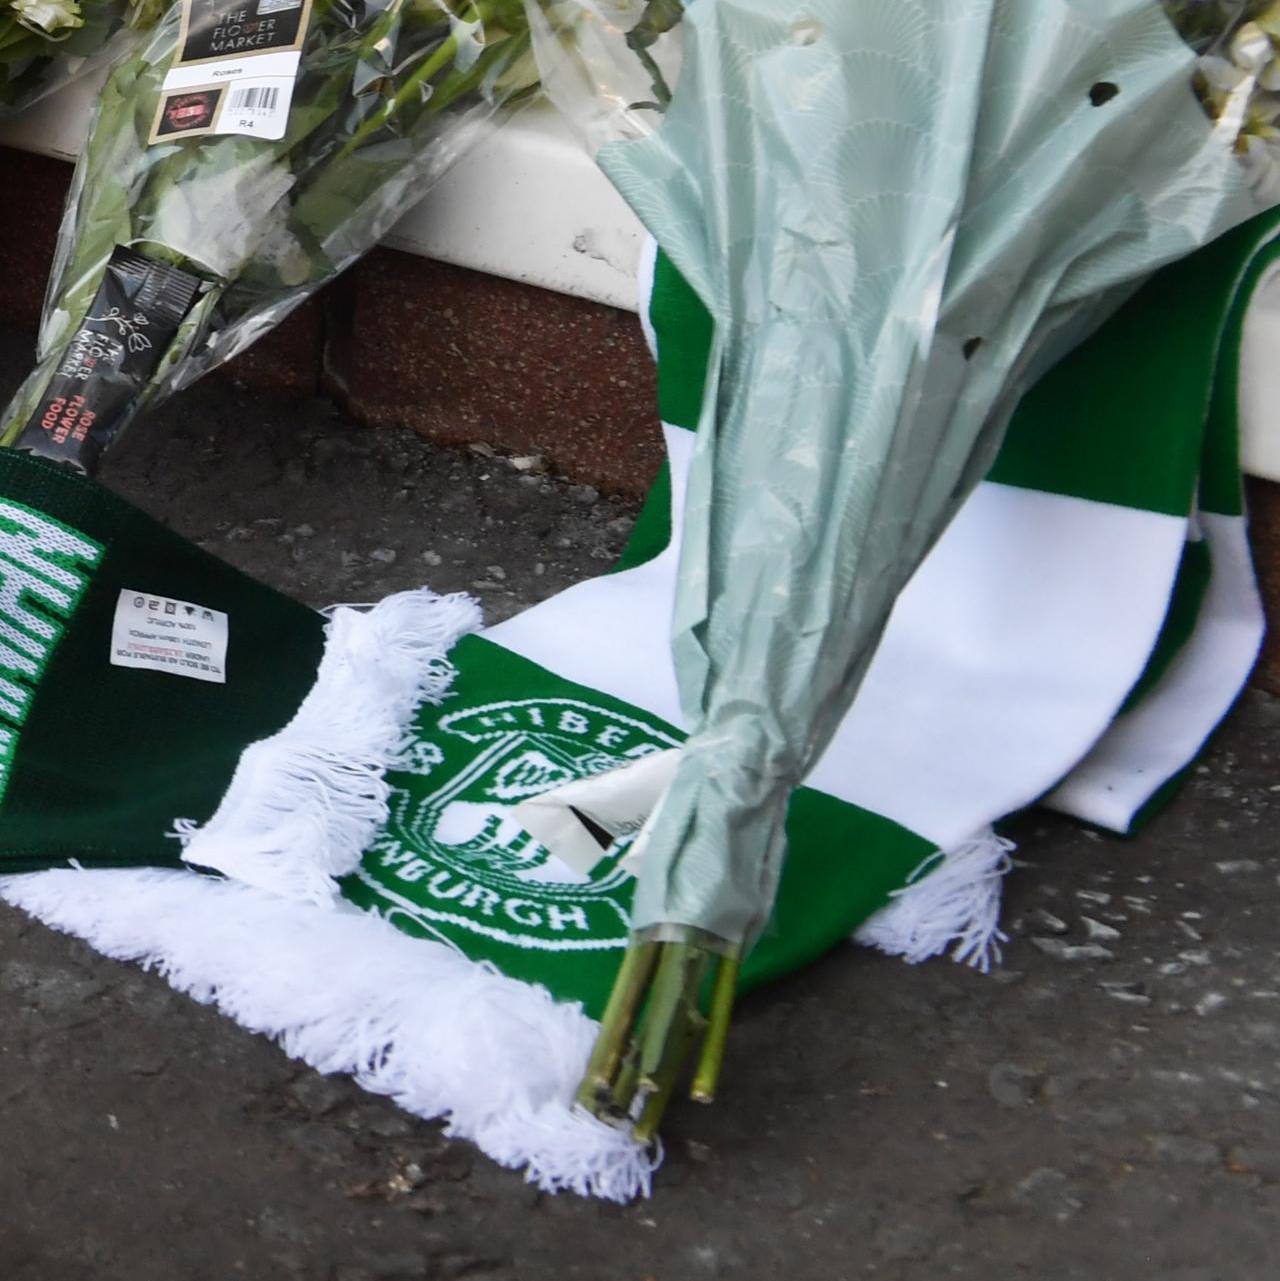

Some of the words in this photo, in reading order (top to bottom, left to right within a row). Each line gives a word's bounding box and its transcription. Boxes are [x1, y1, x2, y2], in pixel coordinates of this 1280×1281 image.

[216, 10, 248, 24] THE
[209, 32, 277, 51] MARKET
[40, 396, 67, 430] FOOD
[51, 393, 87, 445] FLOWER
[71, 409, 97, 442] ROSE
